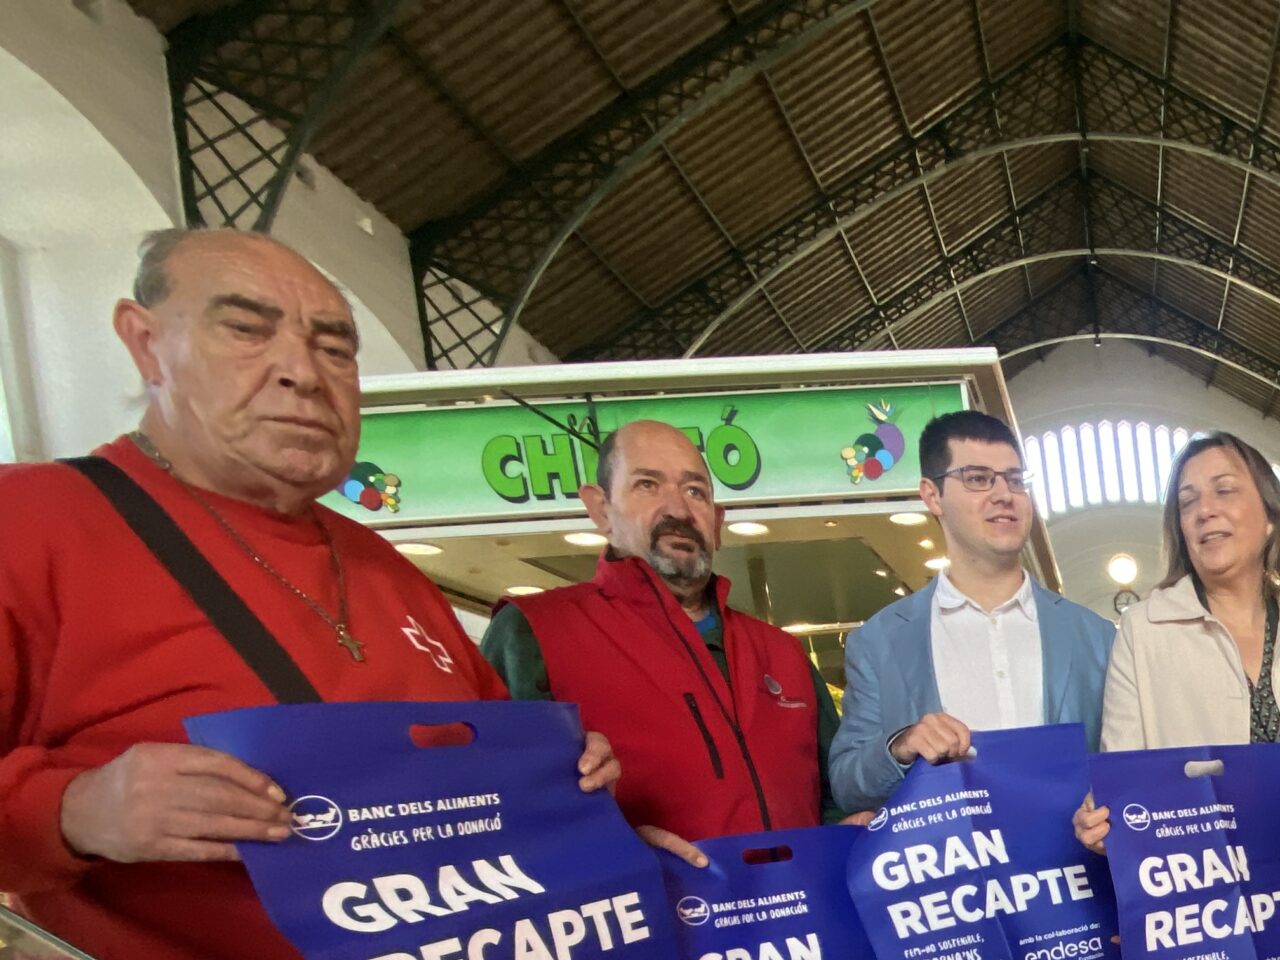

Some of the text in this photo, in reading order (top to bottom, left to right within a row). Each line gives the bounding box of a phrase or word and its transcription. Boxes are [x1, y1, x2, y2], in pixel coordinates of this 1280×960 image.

[348, 793, 500, 822] BANC DELS ALIMENTS
[890, 790, 989, 816] BANC DELS ALIMENTS
[1152, 811, 1176, 820] BANC
[1177, 808, 1197, 817] DELS
[928, 813, 943, 824] PER
[946, 810, 957, 820] LA
[1186, 824, 1199, 834] PER
[1201, 822, 1211, 832] LA
[412, 827, 434, 842] PER
[438, 824, 453, 838] LA
[872, 829, 1009, 890] GRAN
[1138, 845, 1250, 897] GRAN
[322, 854, 546, 933] GRAN
[712, 891, 806, 912] BANC DELS ALIMENTS
[887, 865, 1094, 939] RECAPTE
[756, 911, 767, 921] LA
